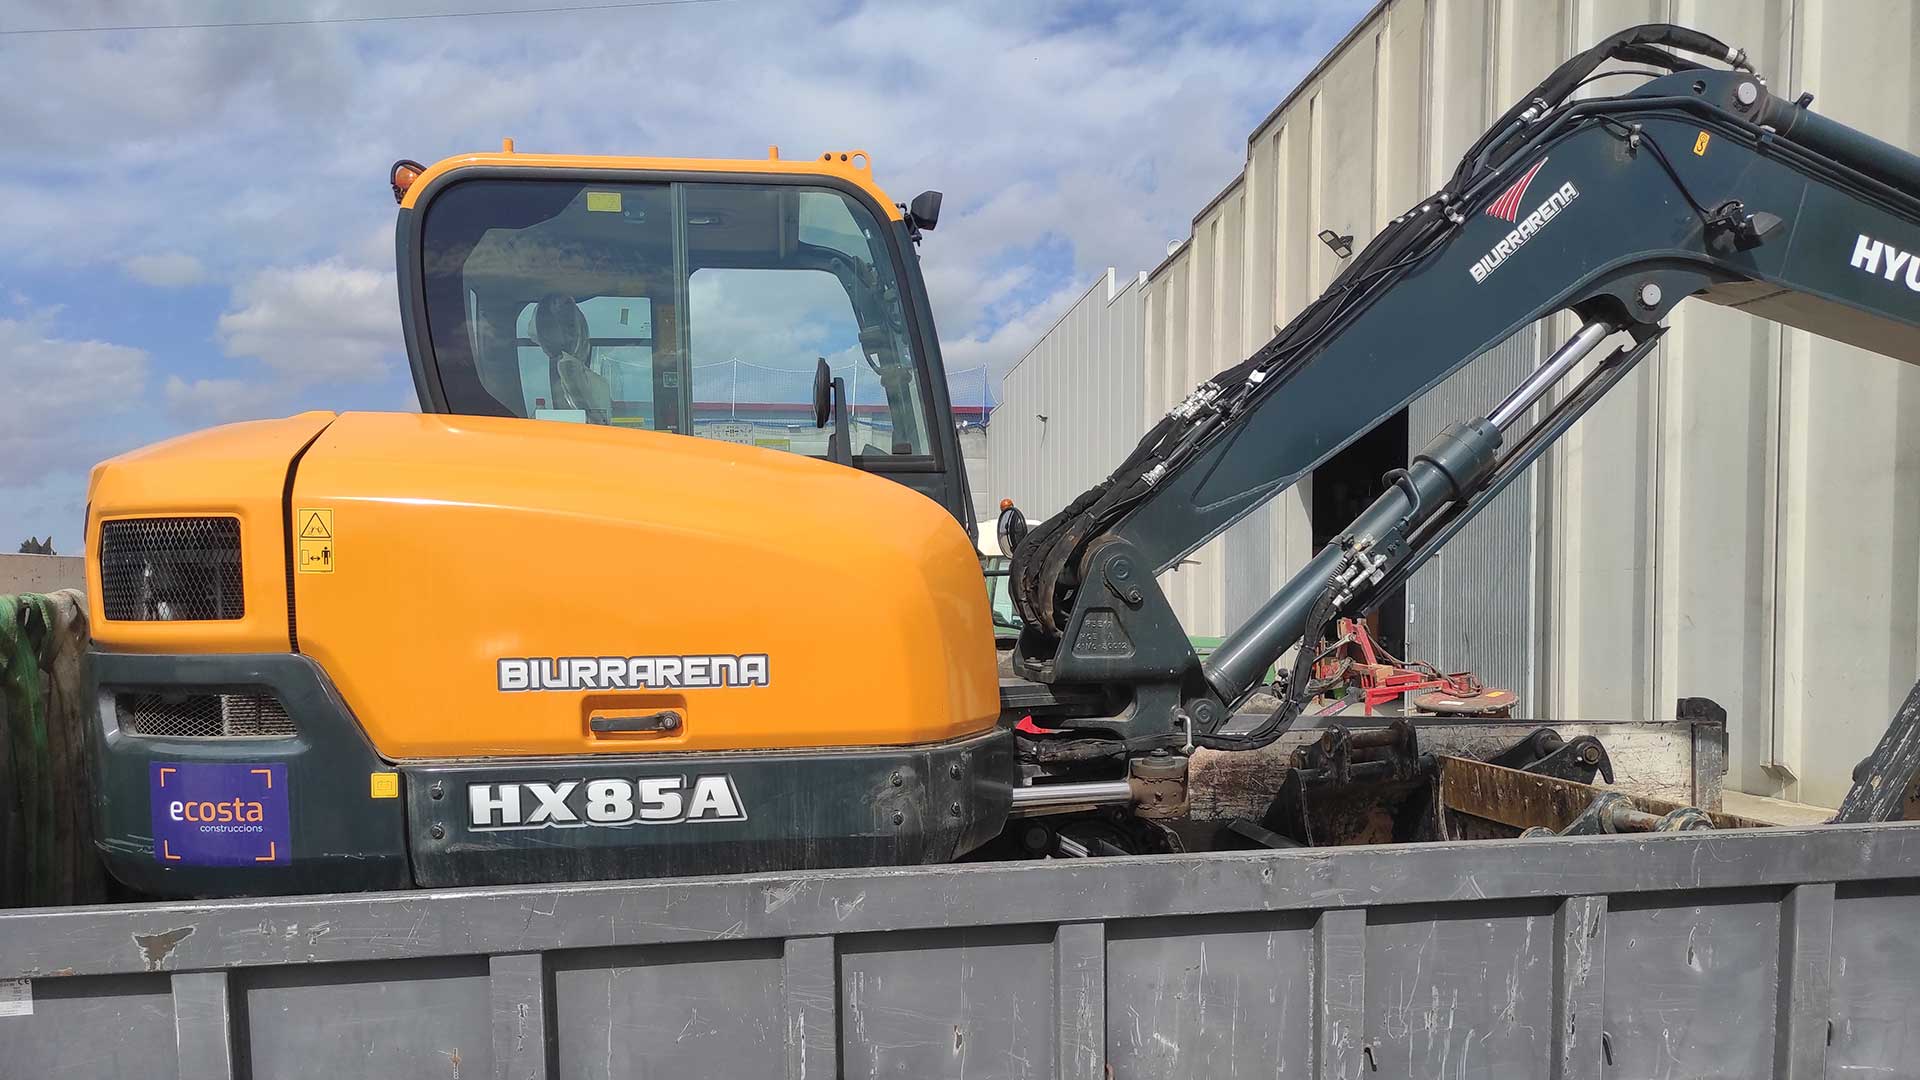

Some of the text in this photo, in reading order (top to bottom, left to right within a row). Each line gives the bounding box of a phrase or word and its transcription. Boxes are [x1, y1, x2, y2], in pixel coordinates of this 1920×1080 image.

[1469, 181, 1579, 284] BIURRARENA
[498, 654, 769, 690] BIURRARENA
[170, 797, 263, 822] ecosta
[469, 775, 744, 828] HX85A
[200, 824, 263, 833] construccions
